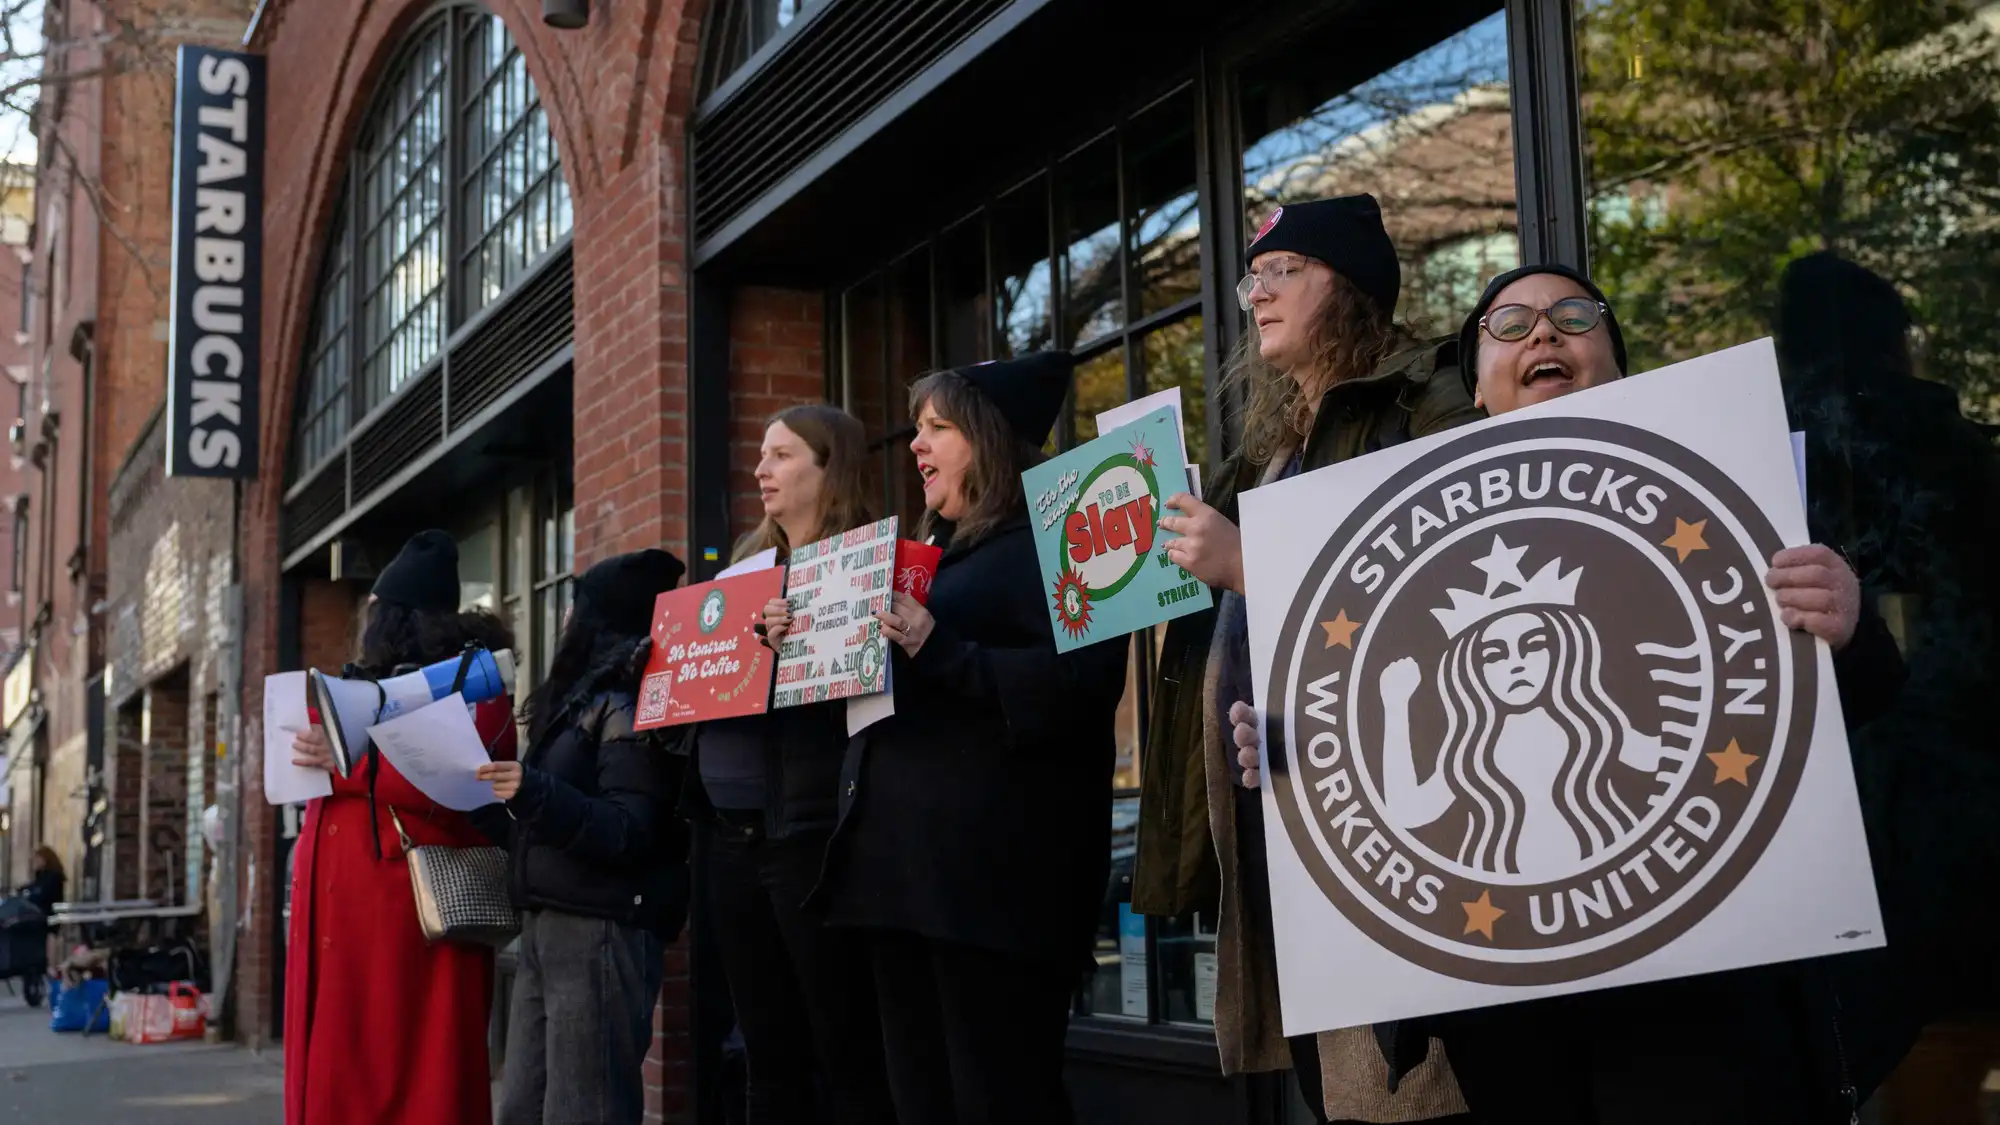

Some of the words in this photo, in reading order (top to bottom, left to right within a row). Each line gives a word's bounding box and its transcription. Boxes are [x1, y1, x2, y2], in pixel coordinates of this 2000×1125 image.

[188, 54, 251, 469] STARBUCKS
[1057, 468, 1079, 495] the
[1098, 489, 1114, 508] TO
[1115, 481, 1131, 500] BE
[1350, 461, 1668, 595] STARBUCKS
[1157, 580, 1200, 607] STRIKE!
[700, 655, 740, 679] Coffee
[1305, 671, 1445, 914] WORKERS
[1528, 796, 1721, 935] UNITED
